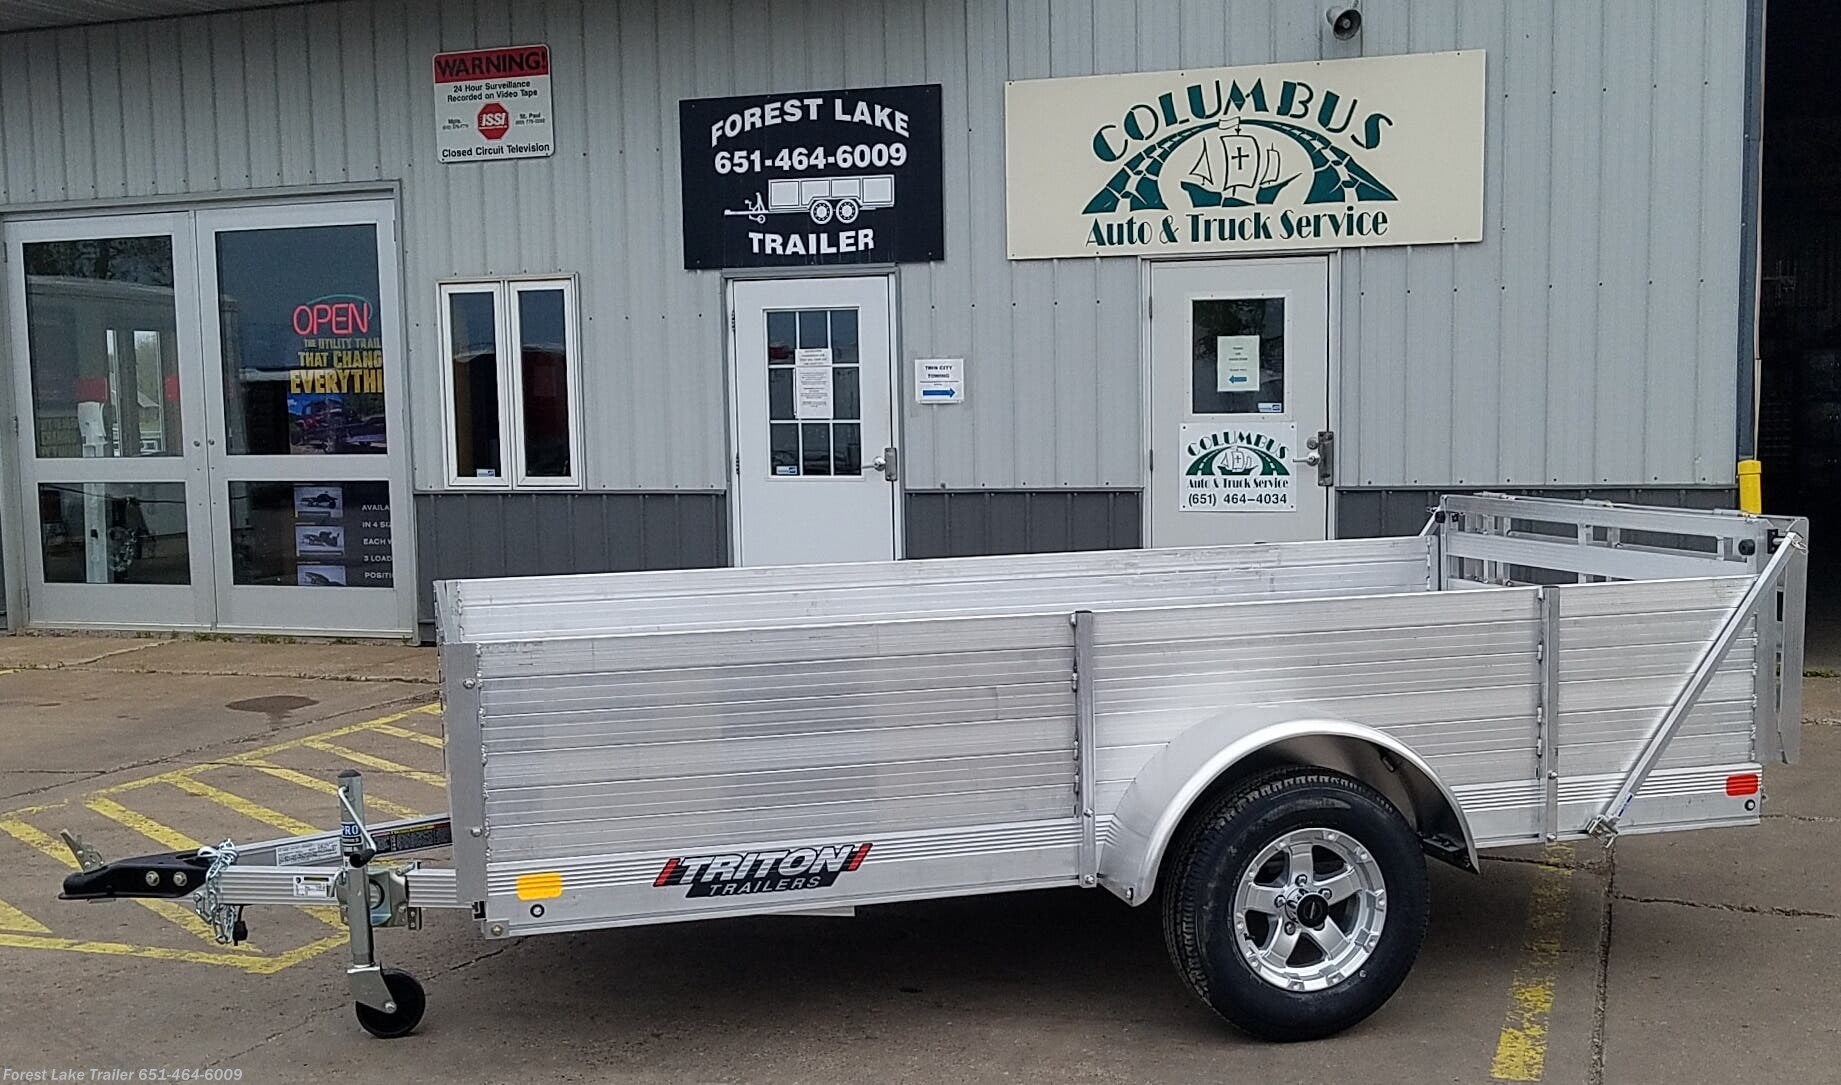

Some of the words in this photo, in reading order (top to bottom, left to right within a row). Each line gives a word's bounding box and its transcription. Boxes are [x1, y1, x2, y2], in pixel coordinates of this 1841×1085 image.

[436, 51, 546, 78] WARNING!
[447, 92, 483, 103] Recorded
[497, 89, 518, 99] Video
[520, 88, 538, 99] Tape
[453, 85, 463, 93] 24
[465, 83, 483, 93] Hour
[485, 80, 531, 91] Surveillance
[711, 98, 824, 148] FOREST
[834, 98, 910, 139] LAKE
[1092, 77, 1393, 162] COLUMBUS
[442, 147, 473, 158] Closed
[476, 145, 504, 156] Circuit
[507, 142, 550, 154] Television
[714, 142, 908, 174] 651-464-6009
[1086, 216, 1153, 247] Auto
[1158, 214, 1180, 244] &
[1186, 211, 1273, 243] Truck
[1279, 205, 1389, 240] Service
[748, 228, 875, 255] TRAILER
[292, 302, 370, 336] OPEN
[318, 338, 352, 349] UTILITY
[355, 338, 382, 349] TRAIL
[298, 352, 328, 367] THAT
[333, 350, 383, 369] CHANG
[289, 369, 383, 393] EVERYTHI
[1187, 431, 1289, 459] COLUMBUS
[1188, 478, 1210, 489] Auto
[1223, 478, 1251, 489] Truck
[1253, 477, 1289, 489] Service
[1188, 493, 1217, 507] (651)
[1223, 493, 1287, 505] 464-4034
[362, 520, 372, 528] IN
[679, 844, 855, 884] TRITON
[709, 876, 821, 896] TRAILERS
